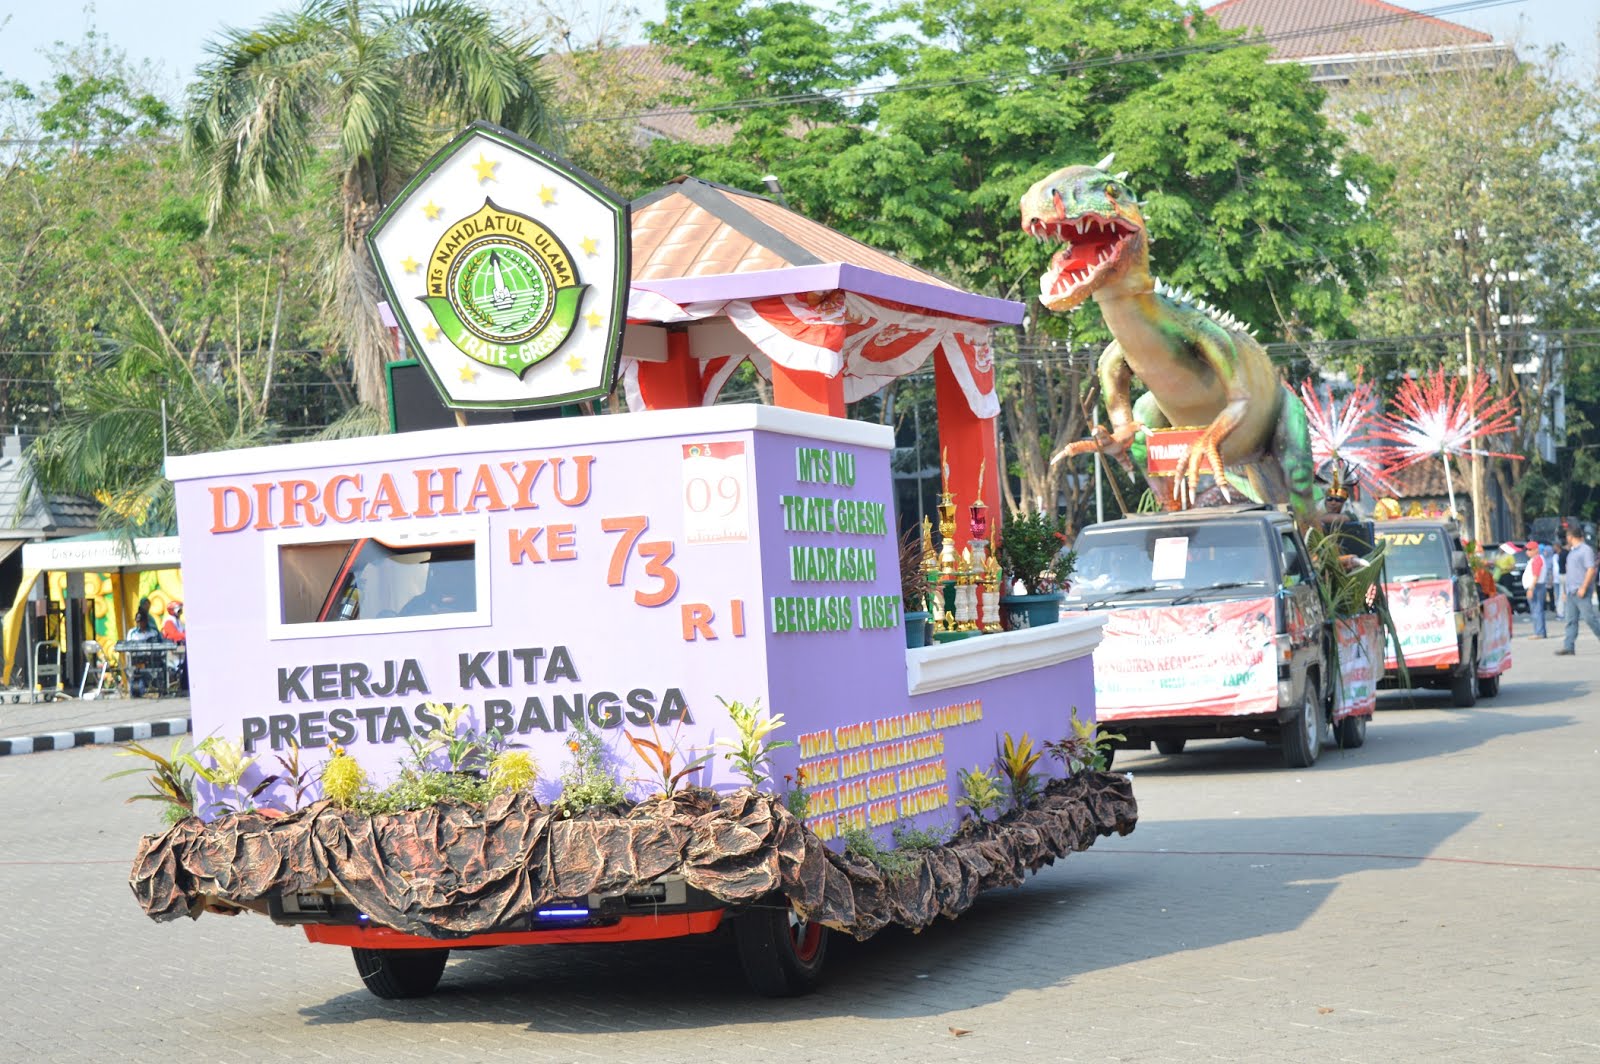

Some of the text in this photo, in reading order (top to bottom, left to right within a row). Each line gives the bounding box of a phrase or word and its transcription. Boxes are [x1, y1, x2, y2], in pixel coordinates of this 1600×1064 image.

[441, 214, 526, 266] NAHDLATUL
[534, 232, 572, 285] ULAMA
[795, 446, 856, 488] MTS NU
[208, 454, 596, 535] DIRGAHAYU
[685, 475, 741, 518] 09
[780, 494, 888, 536] TRATE GRESIK
[508, 522, 578, 566] KE
[601, 514, 680, 608] 73
[789, 545, 878, 582] MADRASAH
[770, 594, 901, 634] BERBASIS RISET
[276, 645, 580, 703] KERJA KITA
[485, 686, 695, 736] BANGSA
